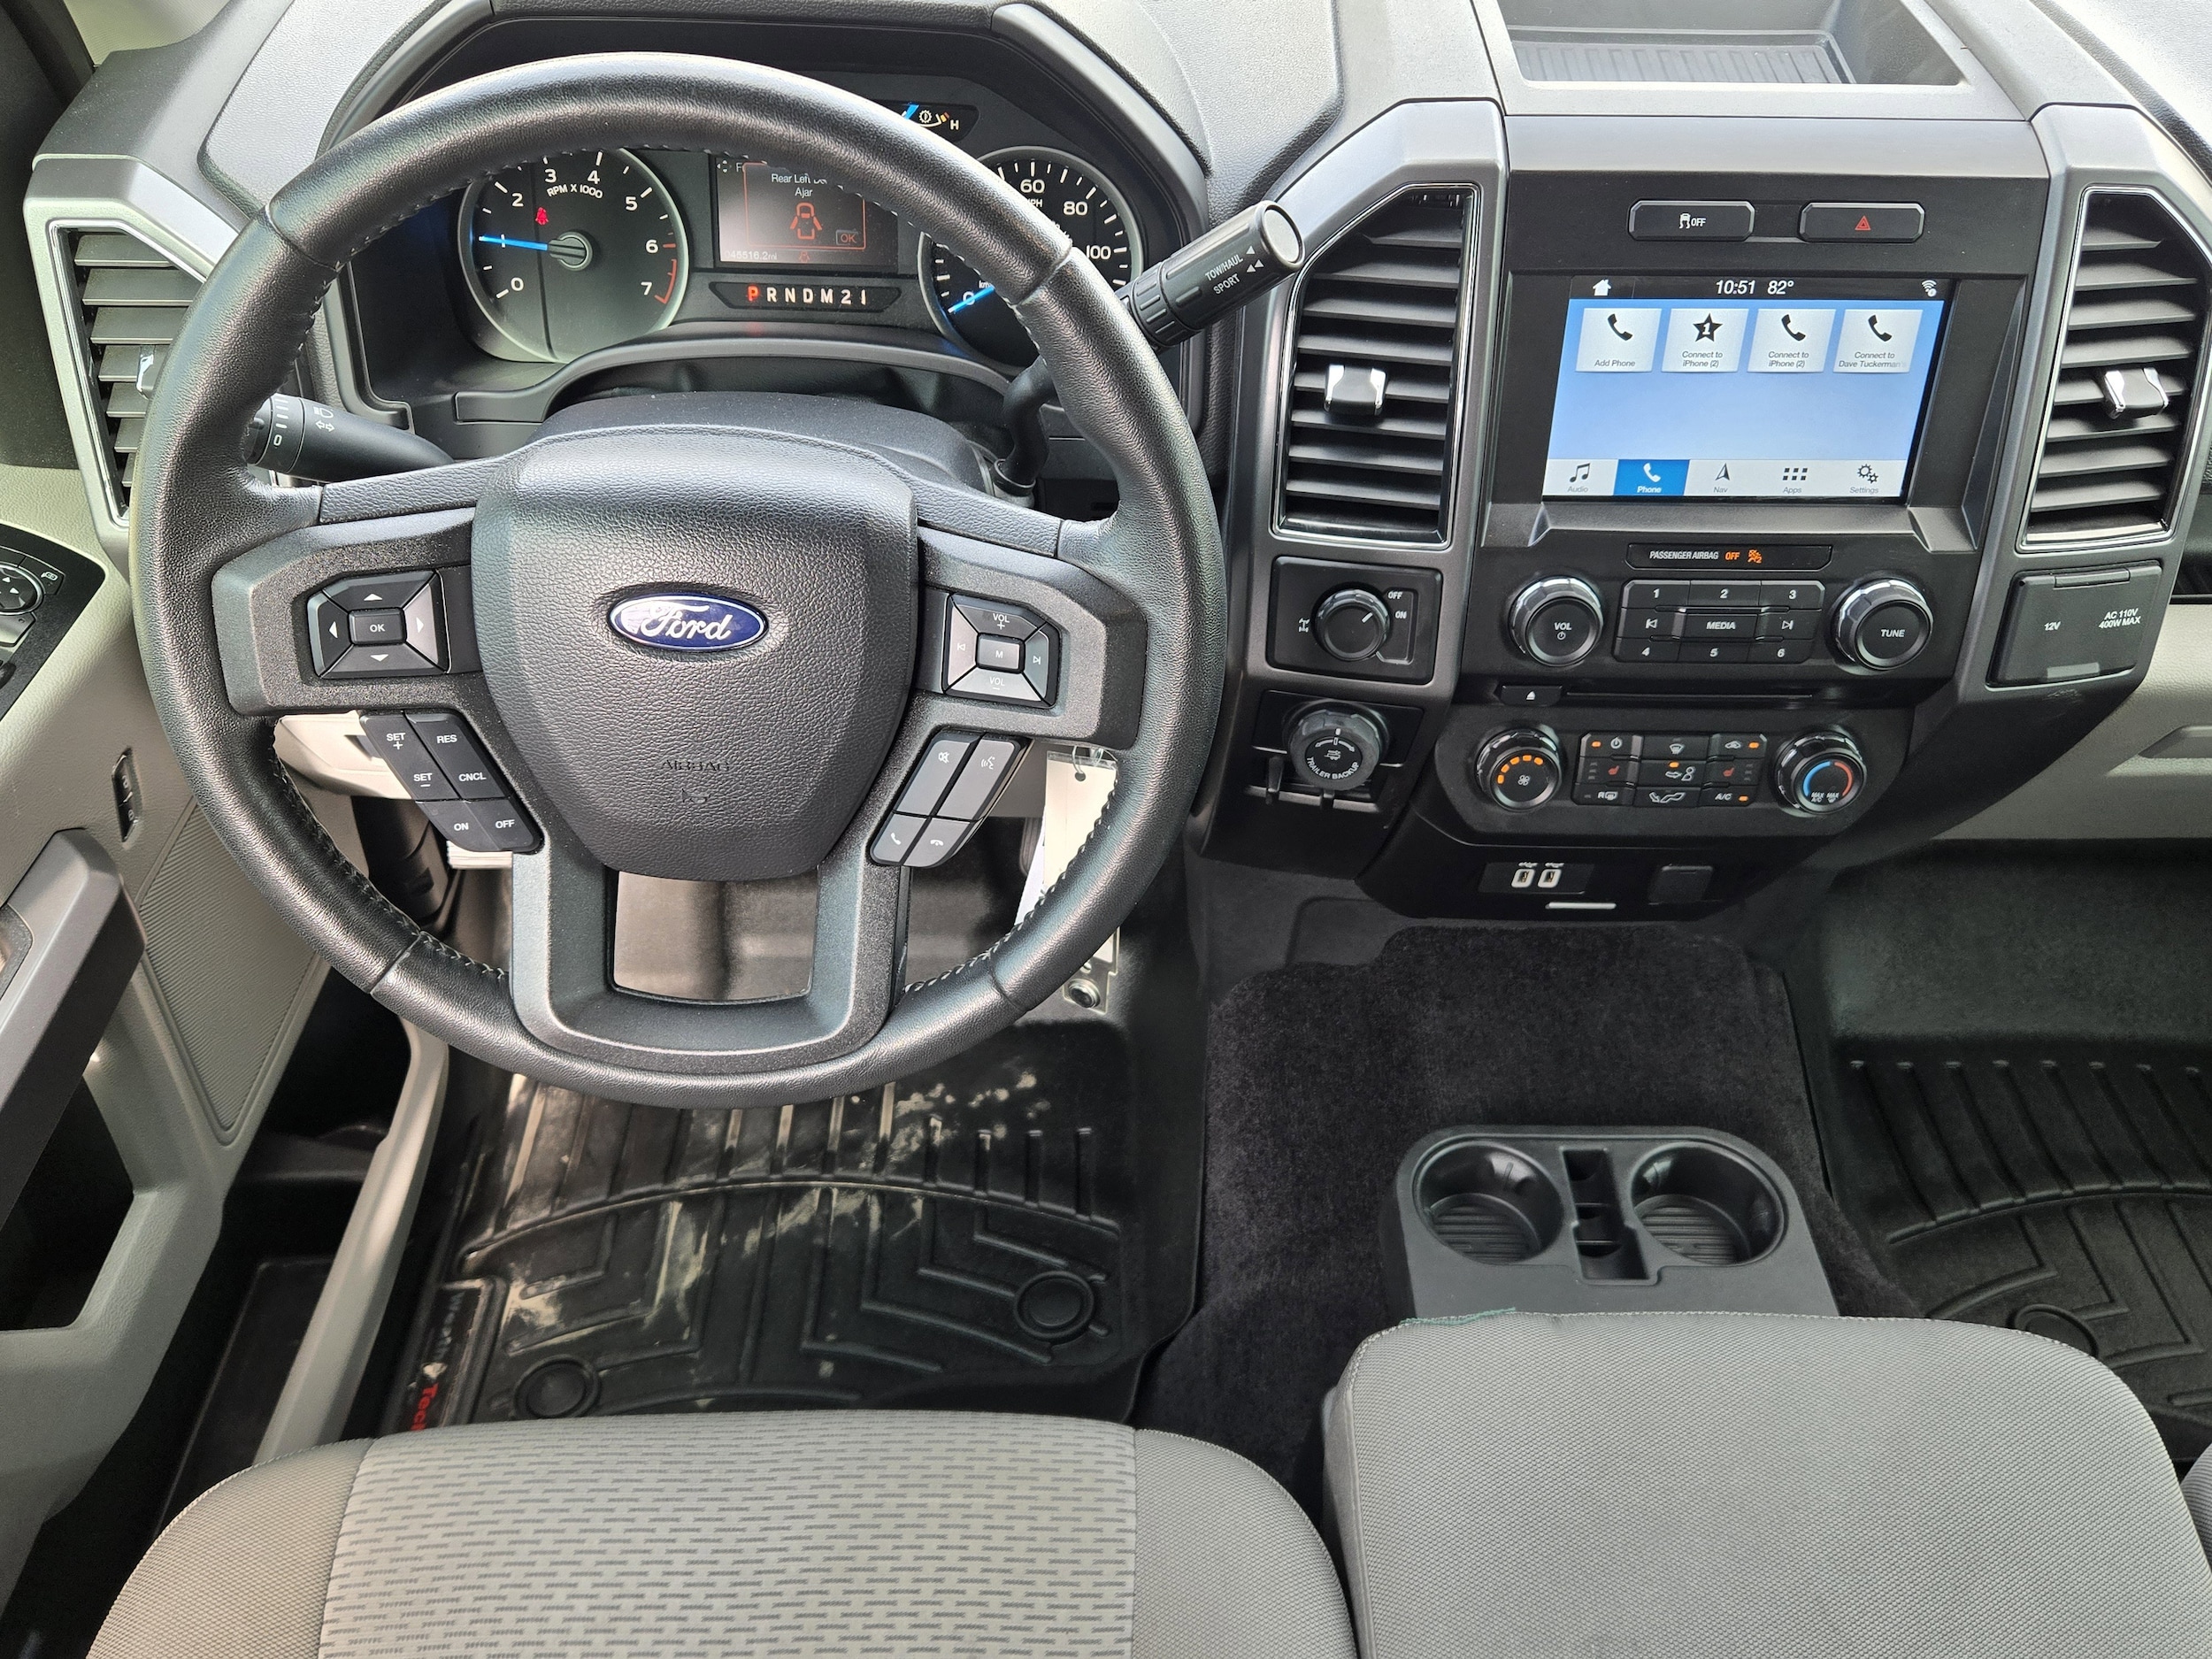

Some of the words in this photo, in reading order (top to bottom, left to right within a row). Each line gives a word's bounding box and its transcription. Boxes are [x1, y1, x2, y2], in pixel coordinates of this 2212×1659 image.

[950, 119, 959, 130] H
[545, 169, 557, 183] 3
[587, 170, 600, 184] 4
[772, 173, 792, 183] Rear
[547, 184, 568, 196] RPM
[580, 184, 603, 198] 1000
[1020, 179, 1045, 193] 60
[795, 187, 812, 198] Ajar
[512, 194, 524, 207] 2
[626, 196, 637, 211] 5
[1027, 198, 1043, 208] PH
[1064, 202, 1088, 215] 80
[1691, 218, 1706, 227] OFF
[841, 234, 856, 243] OK
[646, 240, 658, 253] 6
[1086, 245, 1111, 259] 100
[1205, 254, 1243, 281] TOW/HAUL
[511, 278, 524, 290] 0
[641, 282, 652, 295] 7
[1213, 273, 1240, 295] SPORT
[1717, 280, 1755, 295] 10:51
[1768, 280, 1794, 295] 82°
[1849, 487, 1878, 495] Settings
[1649, 550, 1691, 559] PASSENGER
[1692, 551, 1719, 560] AIRBAG
[1724, 551, 1740, 560] OFF
[1388, 591, 1402, 600] OFF
[1653, 588, 1660, 598] 1
[1720, 588, 1729, 598] 2
[1788, 590, 1796, 599] 3
[993, 613, 1010, 624] VOL
[1395, 611, 1407, 619] ON
[2104, 611, 2117, 620] AC
[2118, 608, 2139, 618] 110V
[639, 600, 733, 641] Ford
[1706, 621, 1736, 630] MEDIA
[2098, 619, 2122, 629] 400W
[2122, 616, 2141, 626] MAX
[370, 624, 385, 633] OK
[1554, 622, 1571, 631] VOL
[2044, 621, 2061, 631] 12V
[1880, 629, 1905, 638] TUNE
[1641, 647, 1650, 657] 4
[1709, 648, 1718, 657] 5
[1777, 649, 1786, 657] 6
[989, 677, 1005, 687] VOL
[387, 732, 405, 741] SET
[437, 733, 457, 743] RES
[1307, 757, 1331, 779] TRAILER
[1332, 762, 1359, 780] BACKUP
[413, 772, 433, 782] SET
[458, 772, 486, 782] CNCL
[1715, 792, 1732, 801] A/C
[454, 822, 469, 831] ON
[495, 819, 514, 829] OFF
